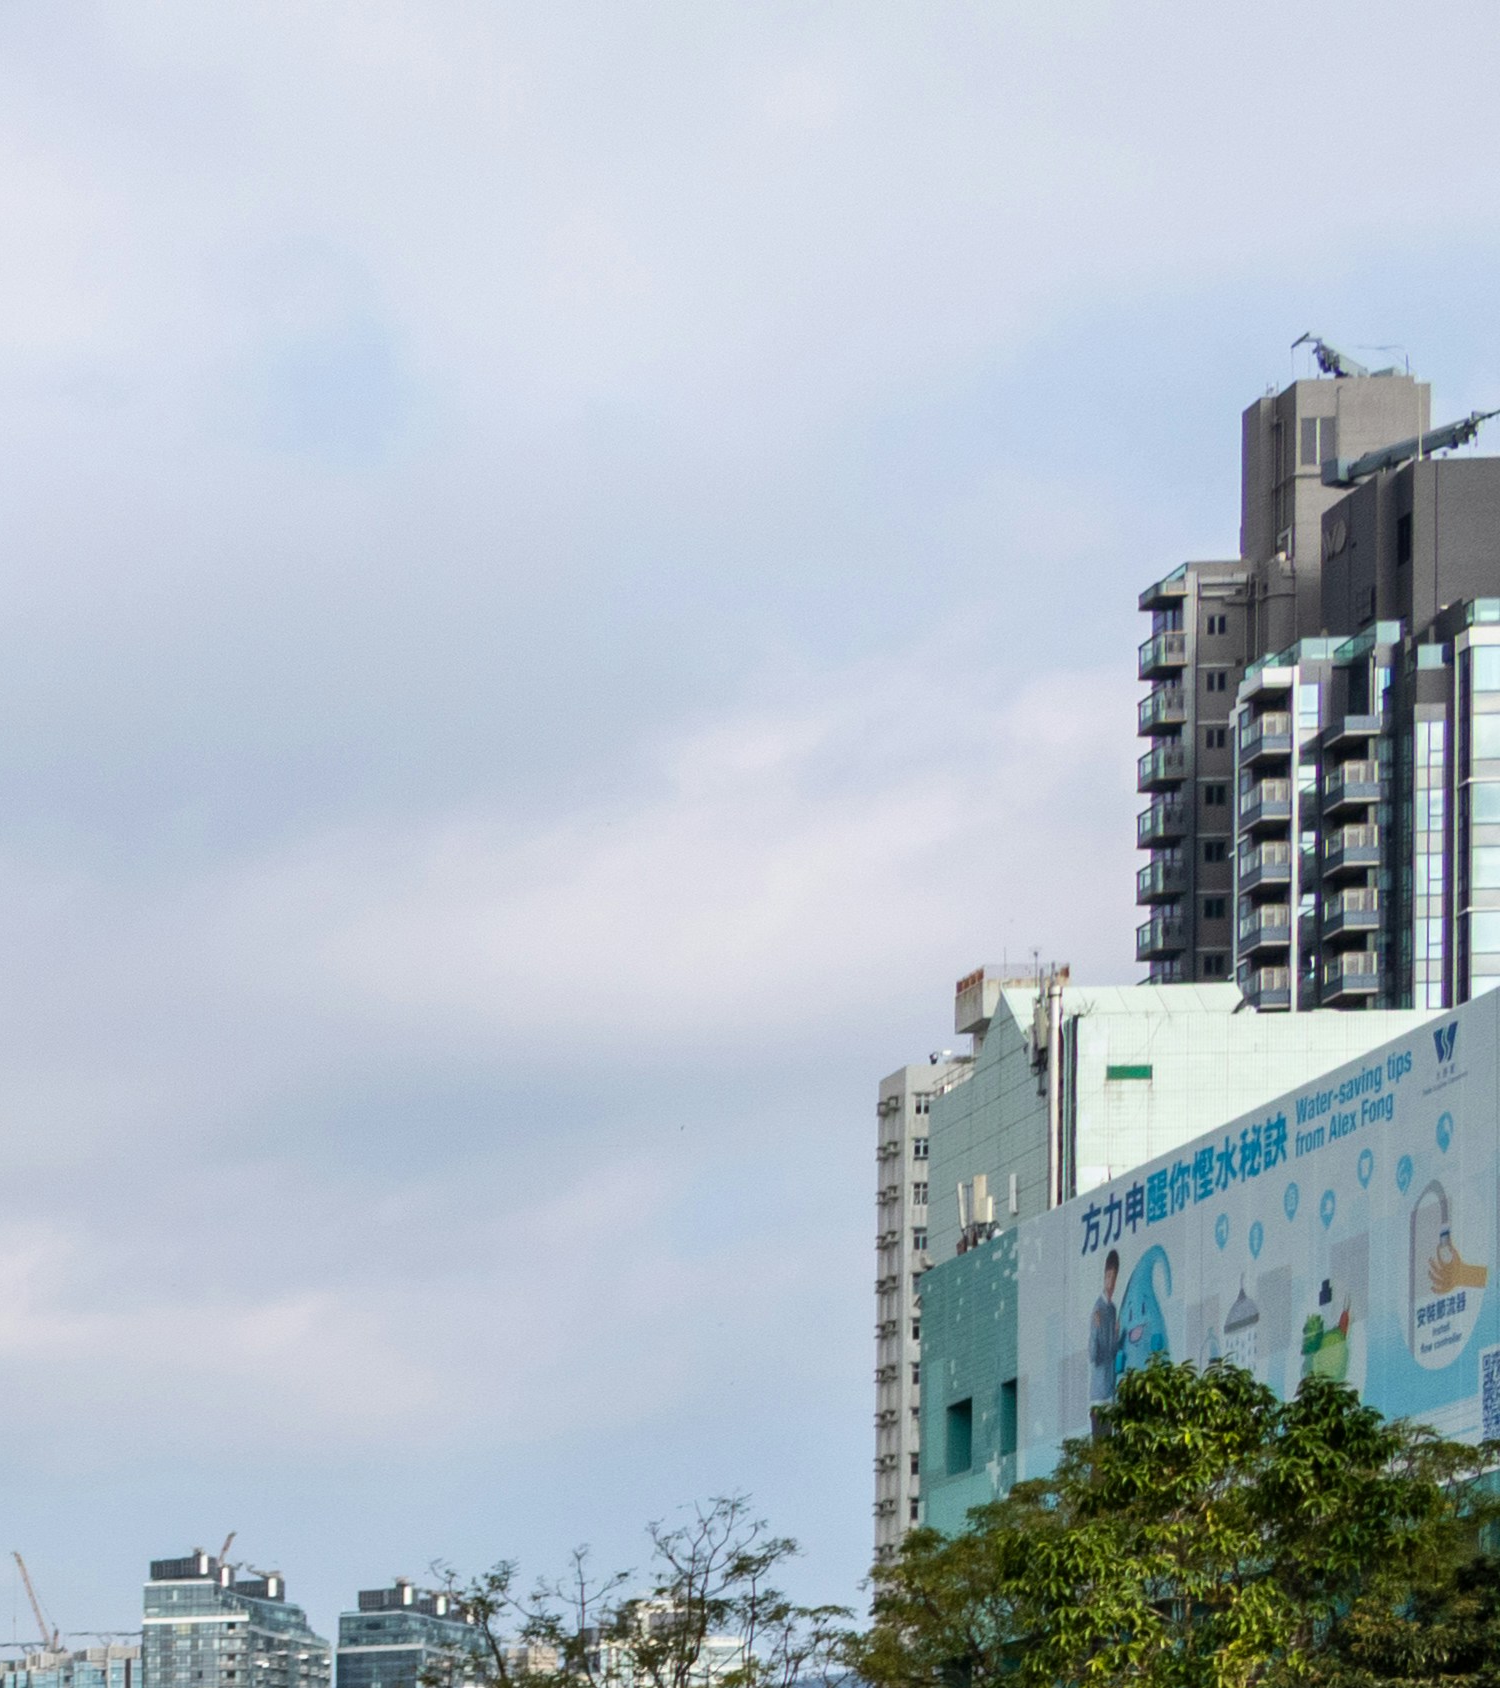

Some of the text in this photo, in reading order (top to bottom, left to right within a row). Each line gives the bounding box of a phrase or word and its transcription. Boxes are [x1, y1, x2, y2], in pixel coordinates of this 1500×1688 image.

[1295, 1065, 1383, 1125] Water-saving
[1386, 1050, 1412, 1083] tips
[1295, 1093, 1393, 1158] from Alex Fong
